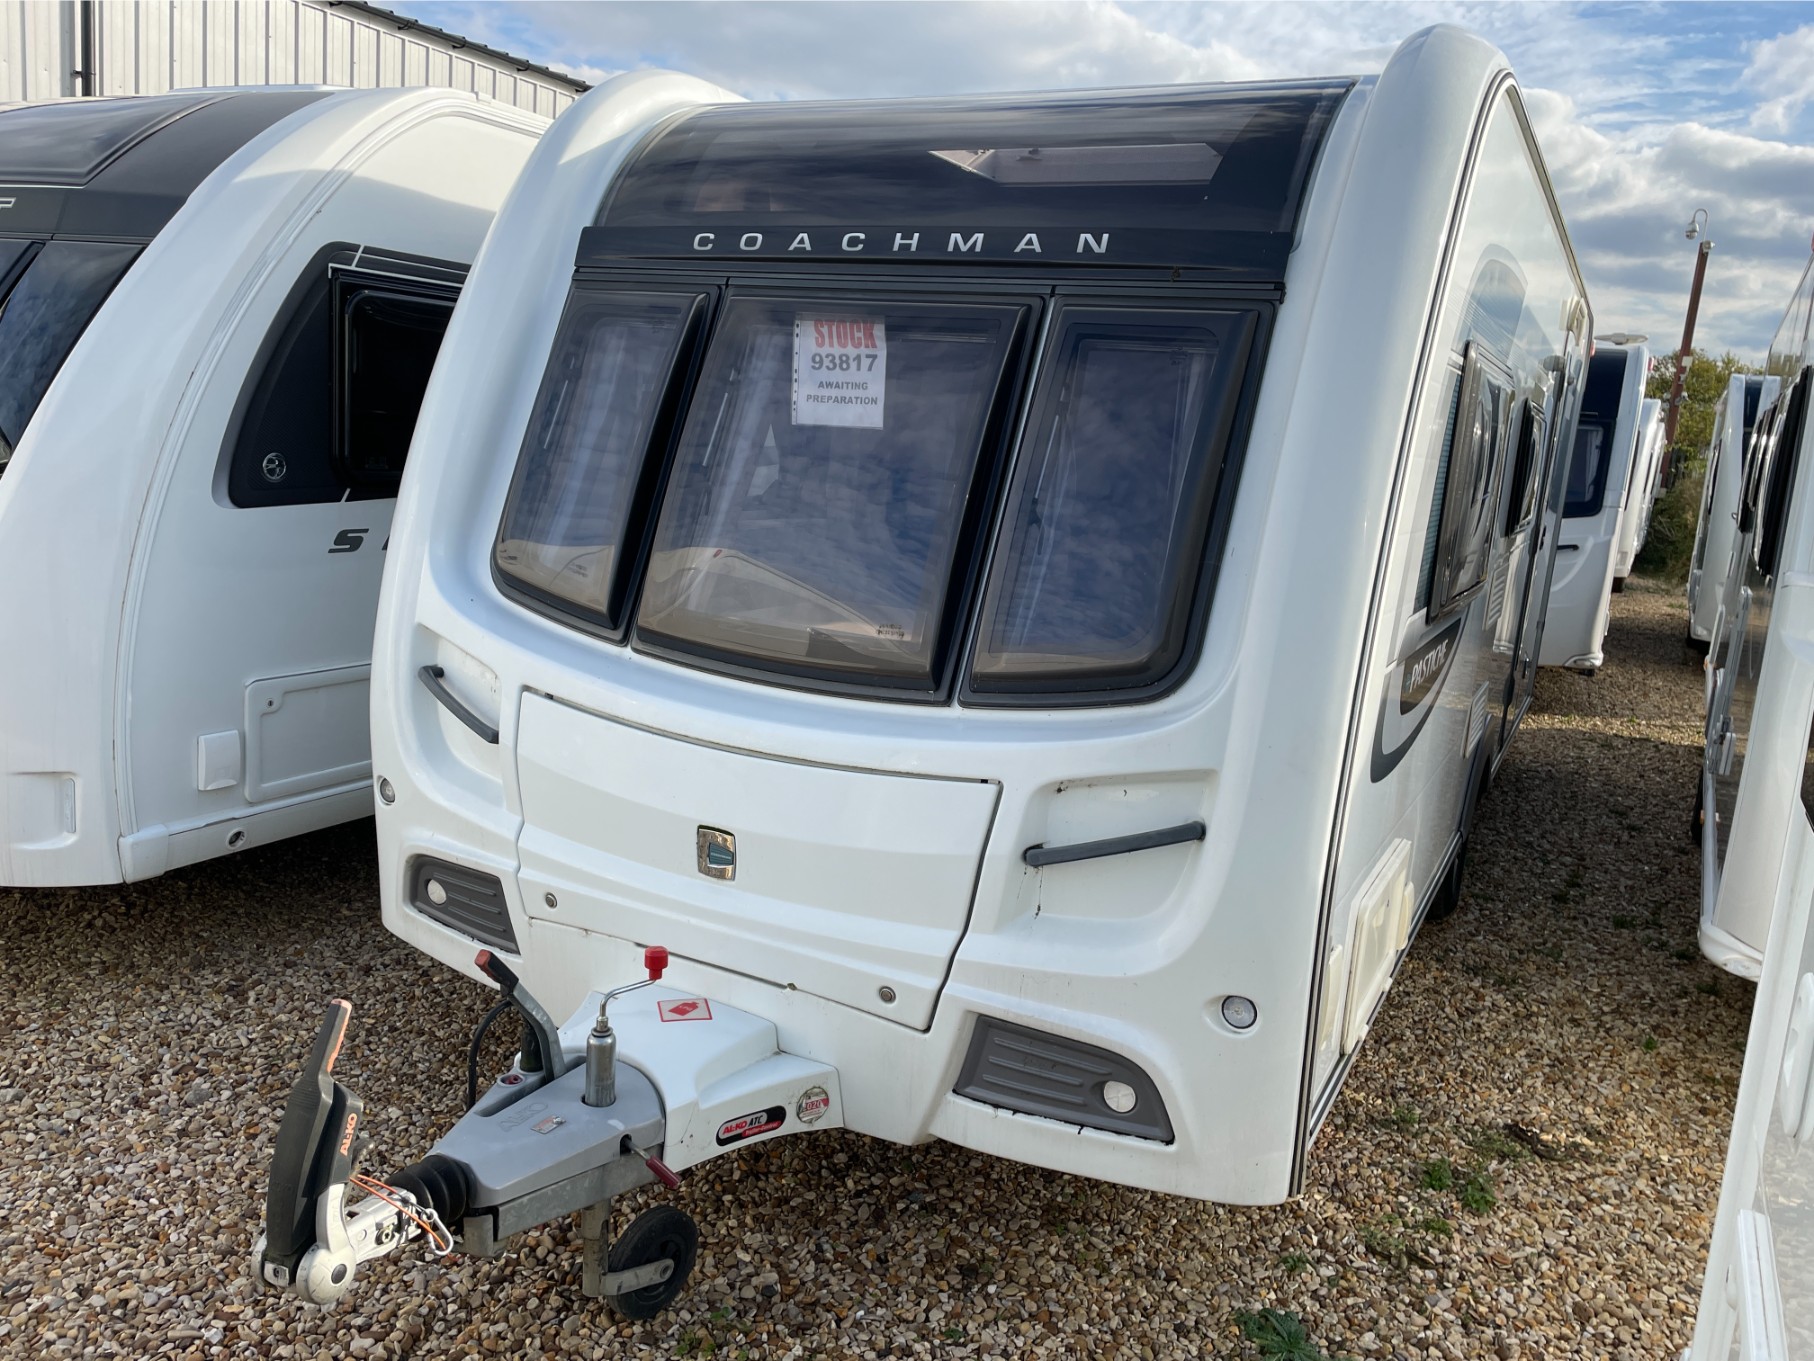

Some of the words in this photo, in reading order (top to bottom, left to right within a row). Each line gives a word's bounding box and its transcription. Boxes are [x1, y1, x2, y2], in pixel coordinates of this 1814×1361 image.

[693, 232, 1109, 253] COACHMAN
[813, 319, 878, 349] STOCK
[811, 352, 878, 372] 93817
[817, 381, 868, 391] AWAITING
[806, 394, 878, 406] PREPARATION
[747, 1115, 764, 1128] ATC
